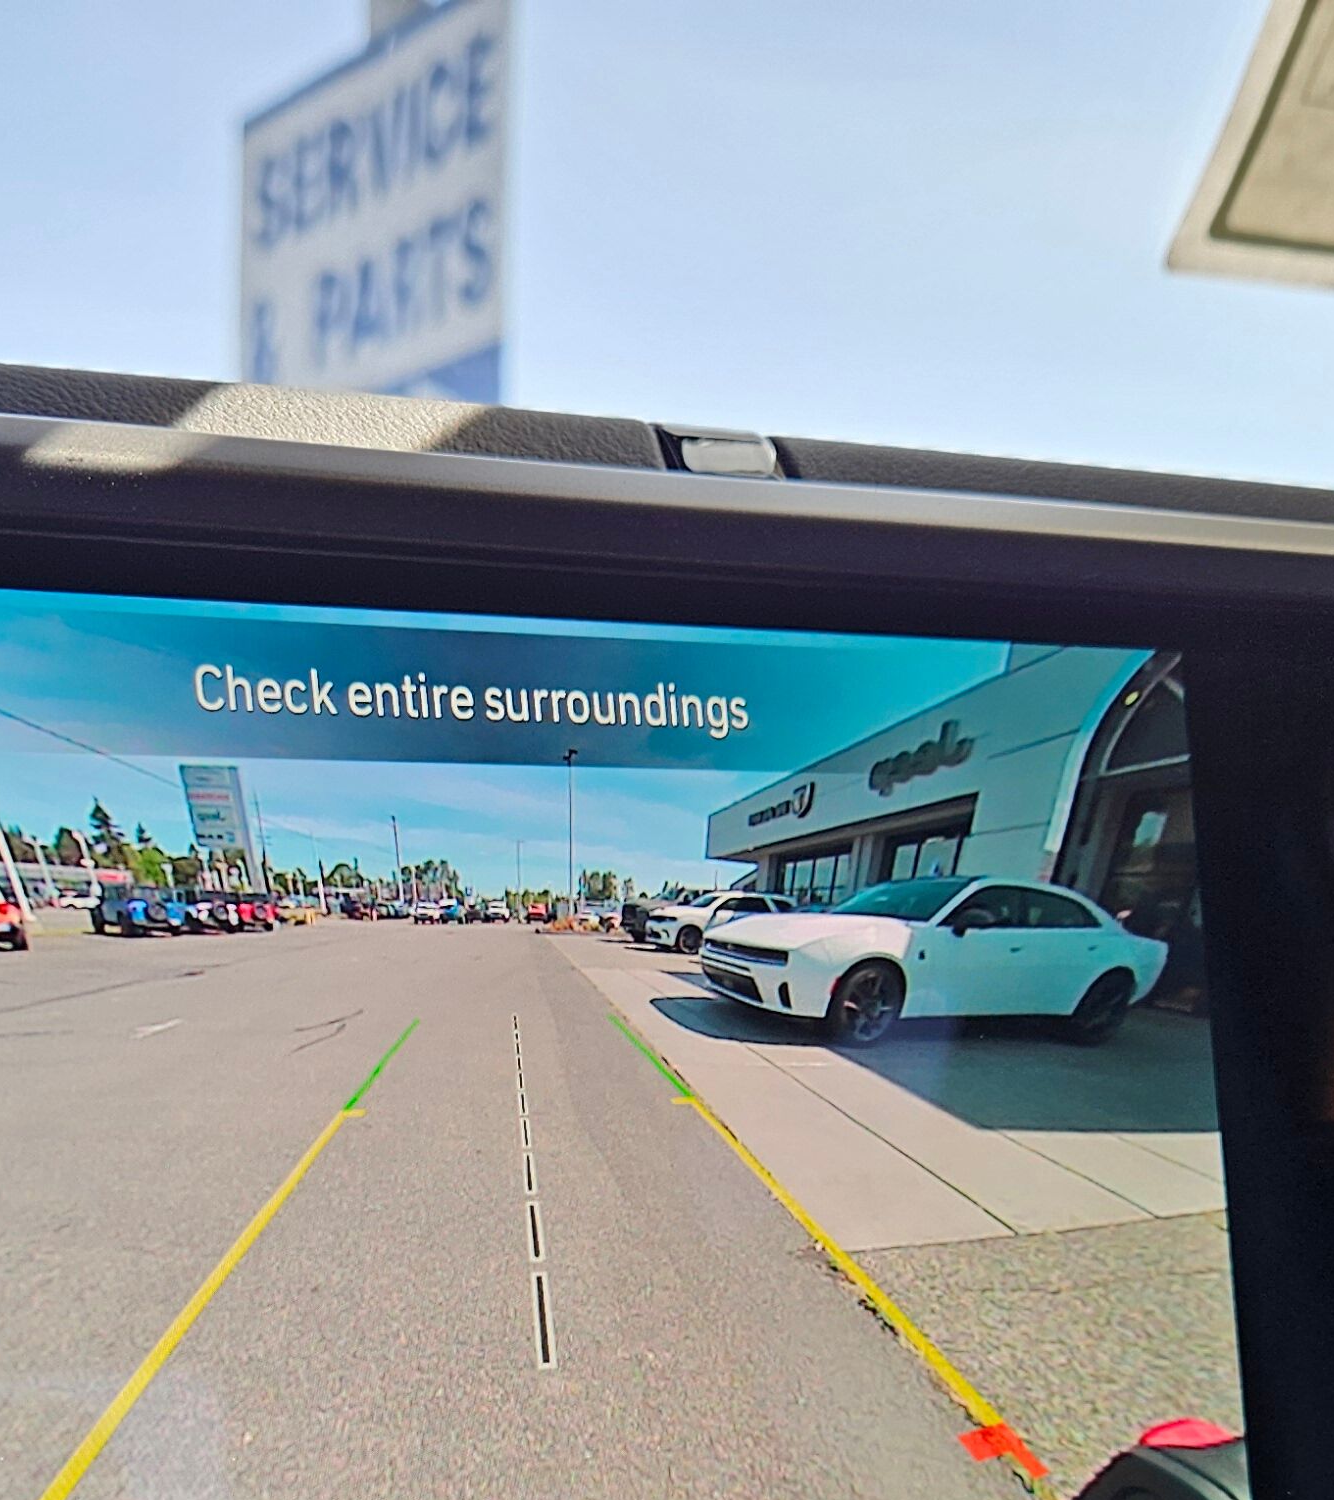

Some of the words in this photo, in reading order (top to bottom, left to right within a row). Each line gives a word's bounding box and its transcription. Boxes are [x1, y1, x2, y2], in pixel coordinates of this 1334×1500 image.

[255, 33, 493, 250] SERVICE
[314, 200, 491, 368] PARTS
[195, 663, 339, 716] Check
[347, 672, 475, 720] entire
[484, 682, 750, 738] surroundings
